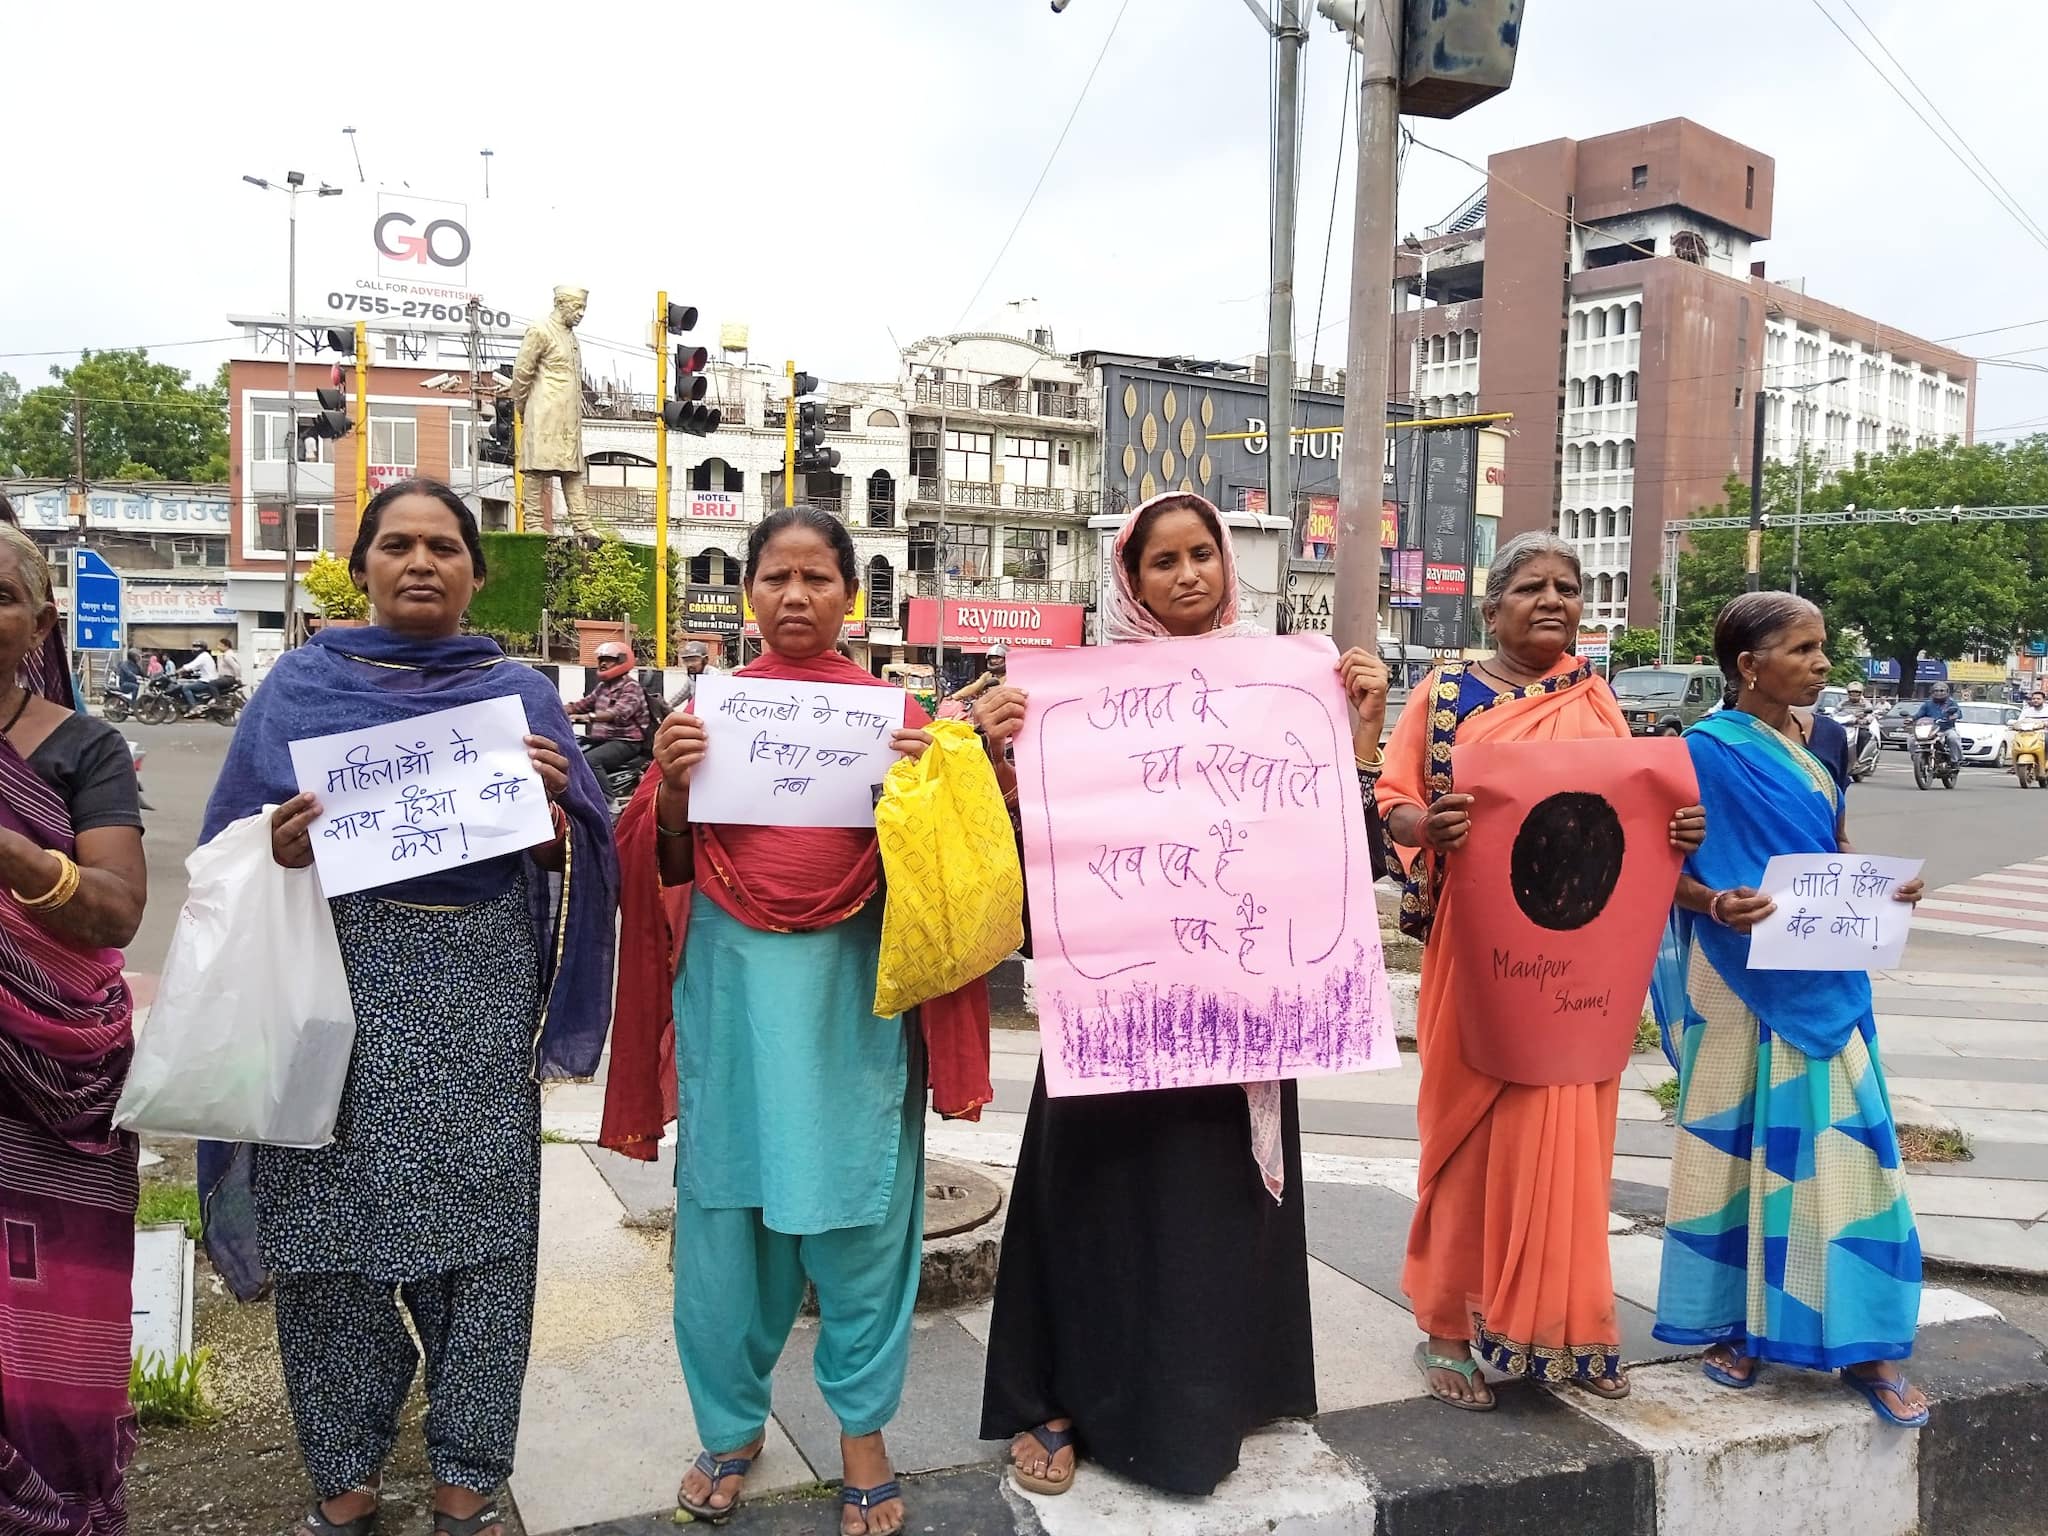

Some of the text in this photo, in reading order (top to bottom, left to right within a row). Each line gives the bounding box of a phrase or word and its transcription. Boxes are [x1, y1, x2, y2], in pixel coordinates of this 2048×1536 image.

[373, 212, 471, 267] GO
[356, 279, 485, 302] CALL FOR ADVERTISING
[692, 503, 737, 517] BRIJ
[697, 493, 731, 502] HOTEL
[689, 603, 737, 614] COSMETICS
[697, 594, 730, 604] LAXMI
[688, 619, 717, 629] General
[718, 621, 739, 630] Store
[980, 635, 1012, 645] GENTS
[1015, 636, 1053, 646] CORNER
[1879, 661, 1890, 675] SBI
[812, 695, 840, 724] के
[1087, 668, 1228, 730] अमन के
[327, 728, 479, 792] महिलाओं के
[1129, 745, 1185, 793] हम
[323, 810, 386, 841] साथ
[395, 784, 457, 824] हिंसा
[1089, 844, 1147, 900] सब
[1158, 843, 1207, 888] एक
[1850, 861, 1896, 899] हिंसा
[1169, 917, 1228, 954] एक
[1493, 947, 1573, 993] Manipur
[1553, 988, 1611, 1017] Shame!
